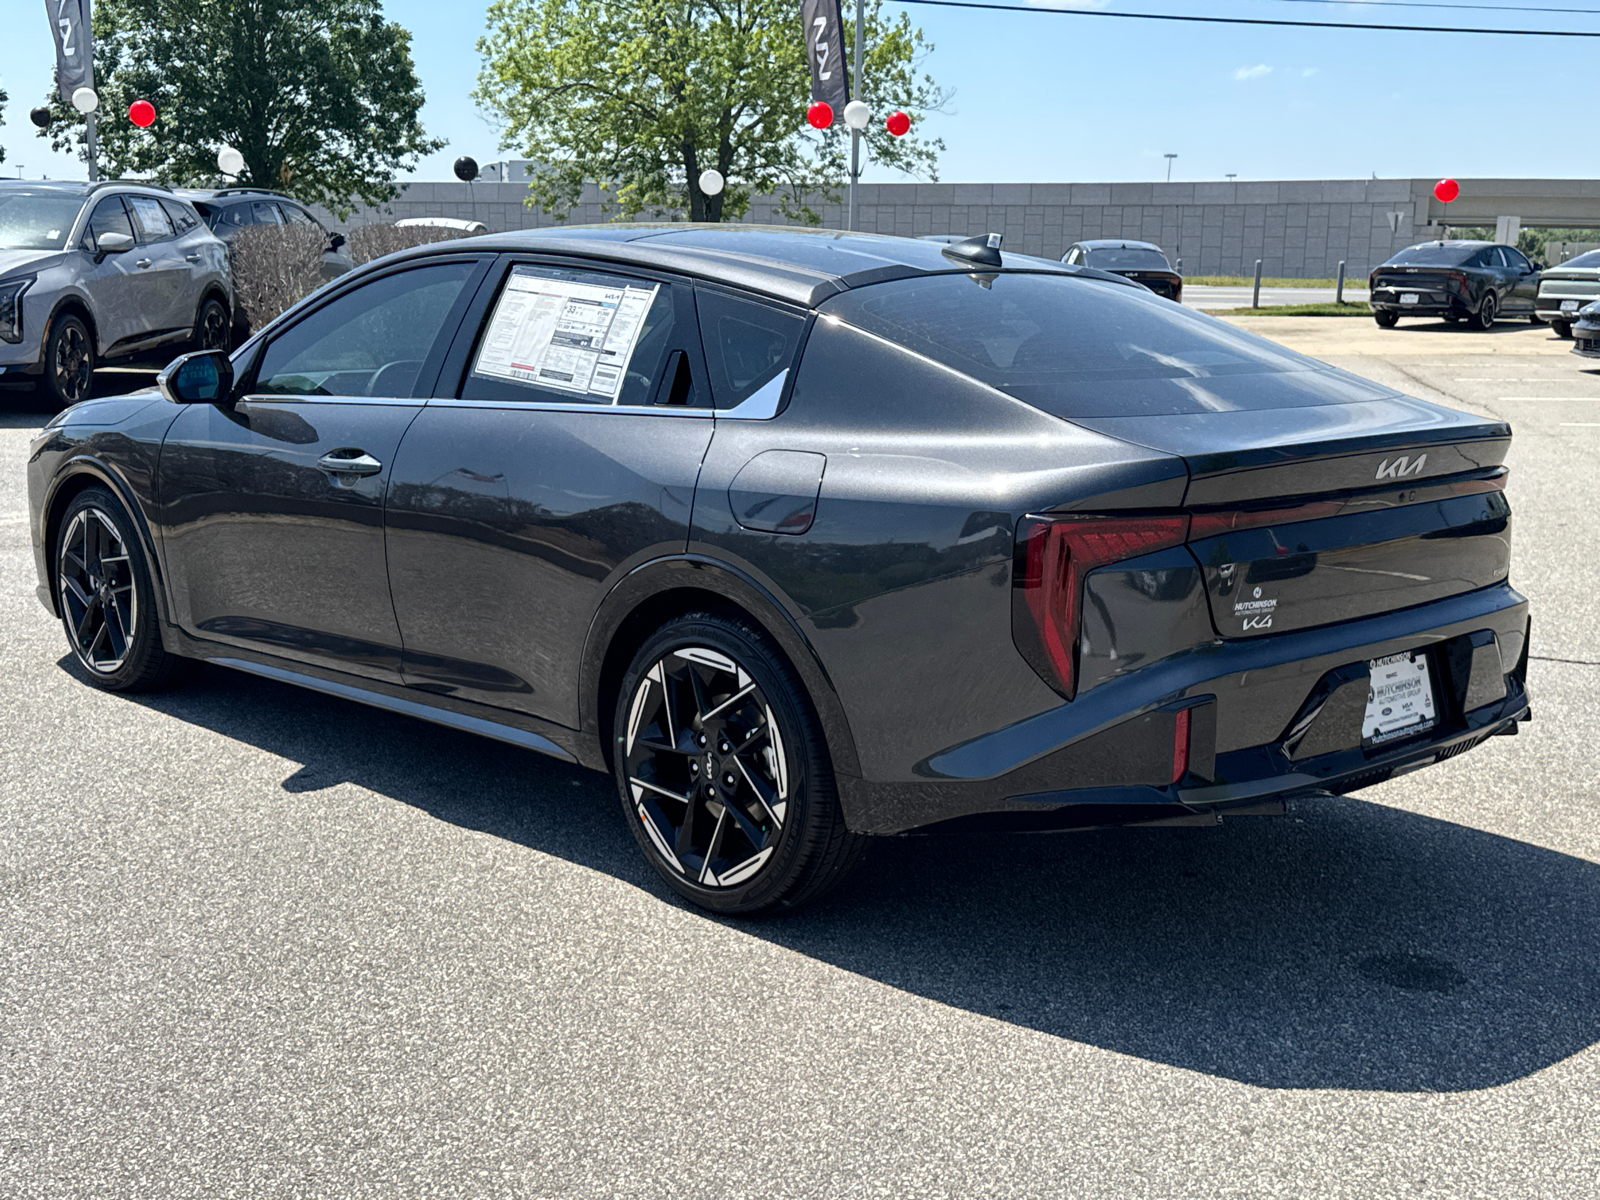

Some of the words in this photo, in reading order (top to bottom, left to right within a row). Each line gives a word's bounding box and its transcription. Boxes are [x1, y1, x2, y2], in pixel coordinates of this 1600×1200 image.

[813, 16, 832, 80] KIA
[1375, 453, 1427, 480] KIA
[1234, 599, 1278, 611] HUTCHINSON
[1234, 608, 1261, 616] AUTOMOTIVE
[1242, 615, 1273, 631] K4
[1376, 651, 1411, 668] HUTCHINSON
[1377, 677, 1422, 698] HUTCHINSON
[1379, 692, 1407, 705] AUTOMOTIVE
[1407, 688, 1421, 699] GROUP
